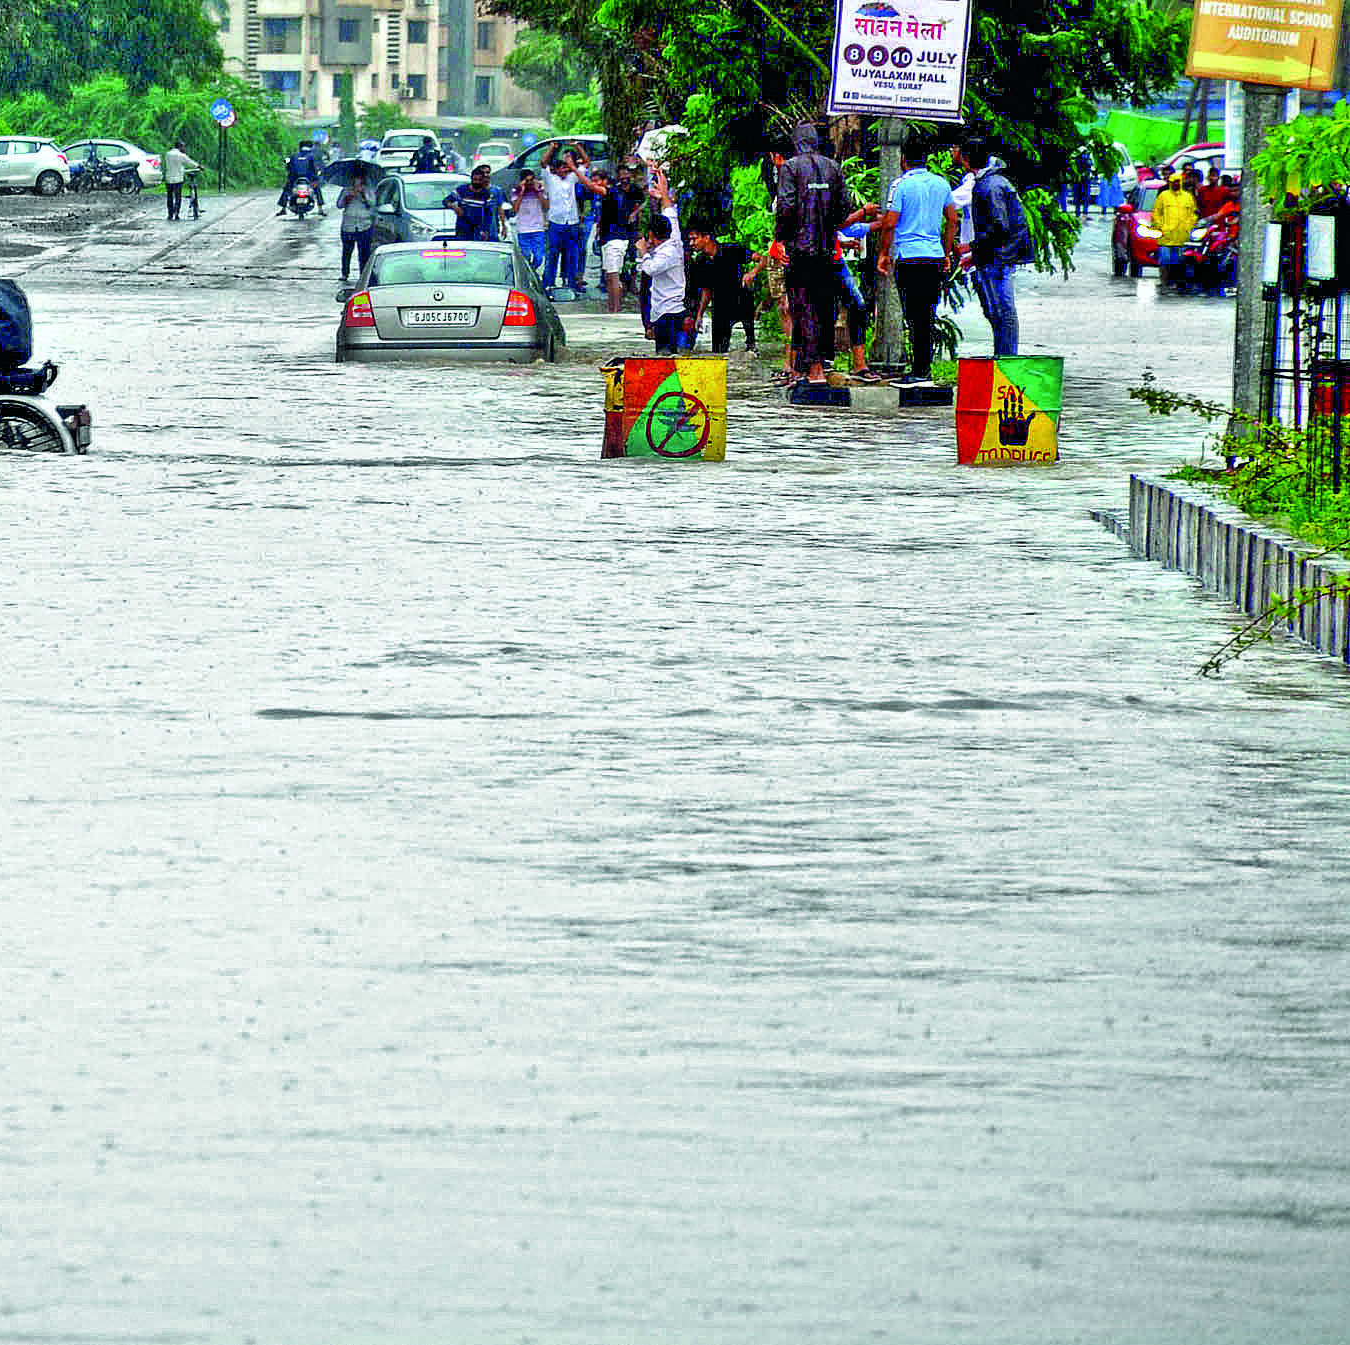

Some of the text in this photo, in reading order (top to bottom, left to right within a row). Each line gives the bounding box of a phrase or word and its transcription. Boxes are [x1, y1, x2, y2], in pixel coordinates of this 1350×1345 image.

[1200, 1, 1333, 28] INTERNATIONAL SCHOOL
[854, 15, 943, 40] सावन मेला
[1227, 24, 1299, 46] AUDITORIUM
[916, 51, 958, 64] JULY
[851, 68, 947, 84] VIJYALAXMI HALL
[897, 83, 923, 91] SURAT
[996, 384, 1027, 401] SAY
